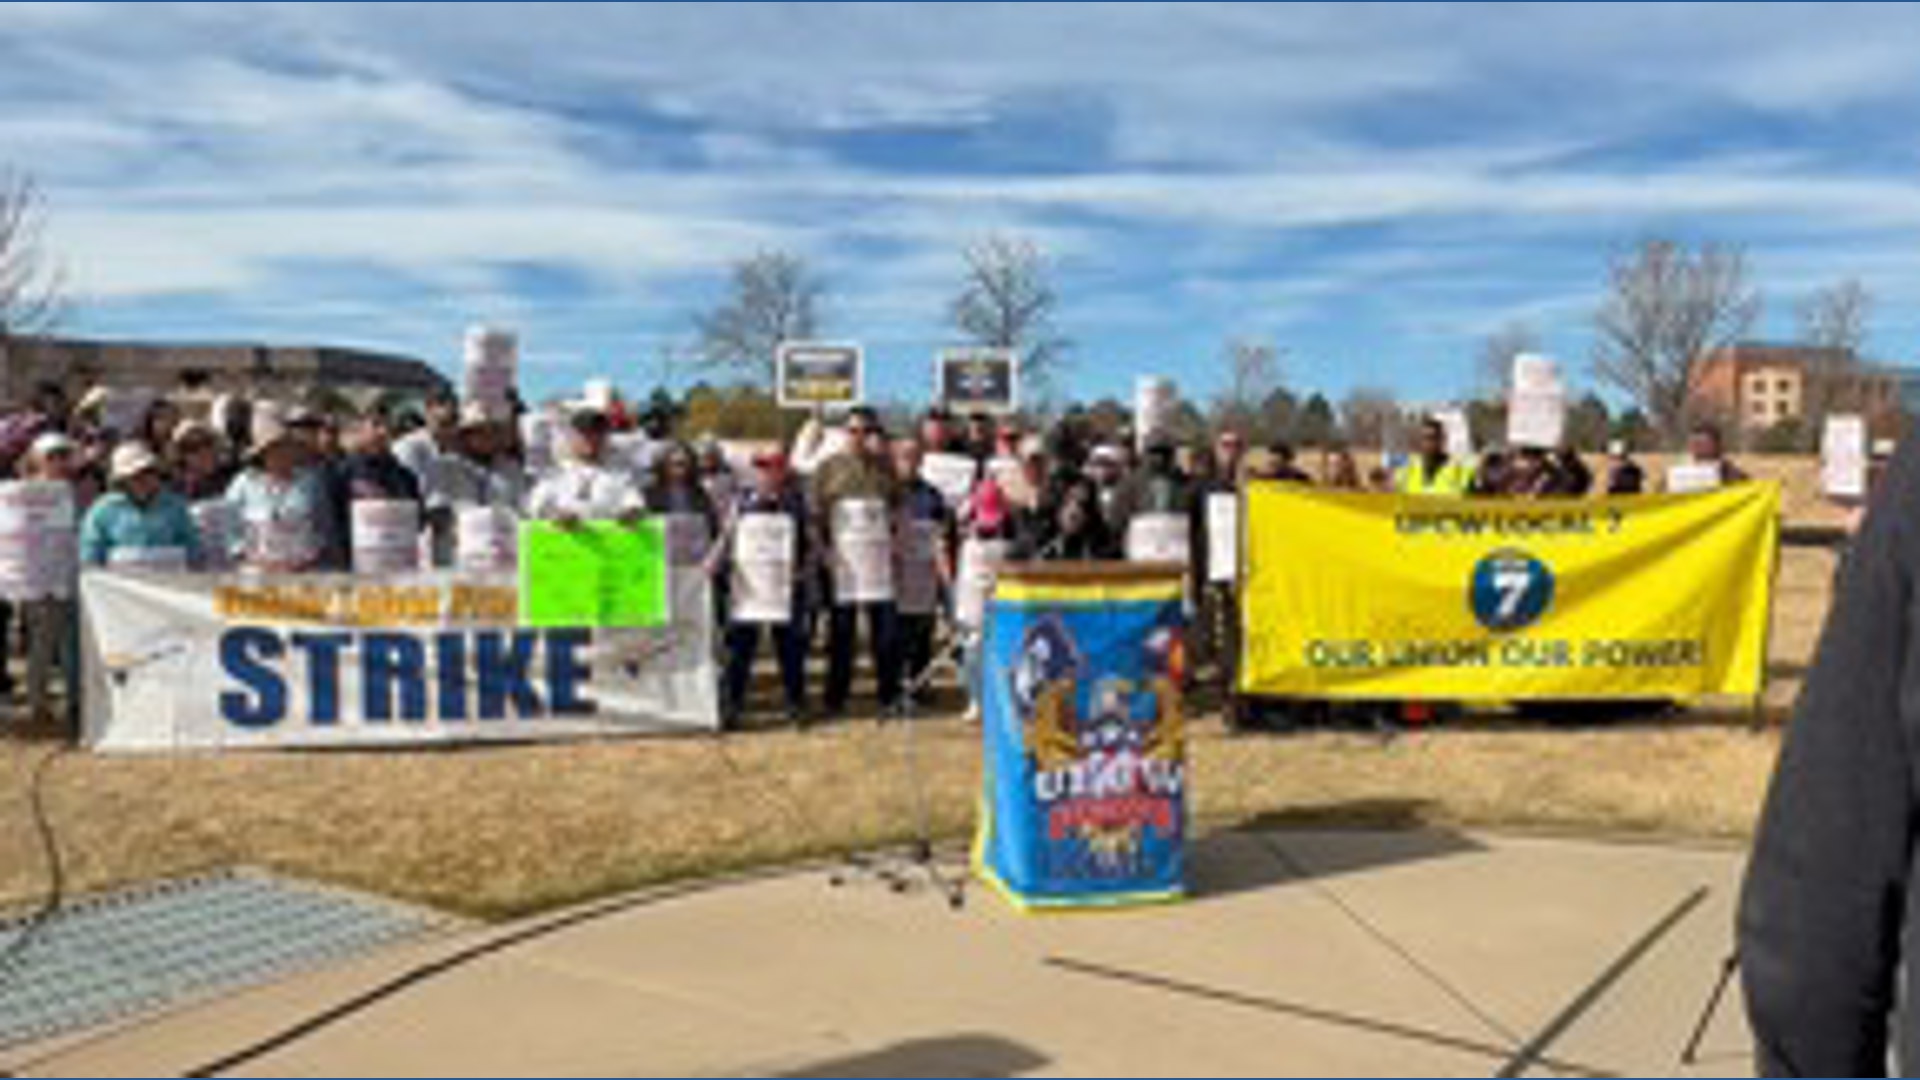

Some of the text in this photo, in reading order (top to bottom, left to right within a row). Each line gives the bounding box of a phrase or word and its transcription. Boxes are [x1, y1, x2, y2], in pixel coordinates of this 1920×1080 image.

[1492, 571, 1530, 618] 7
[1305, 639, 1374, 668] OUR
[1500, 639, 1572, 668] OUR
[219, 627, 597, 728] STRIKE
